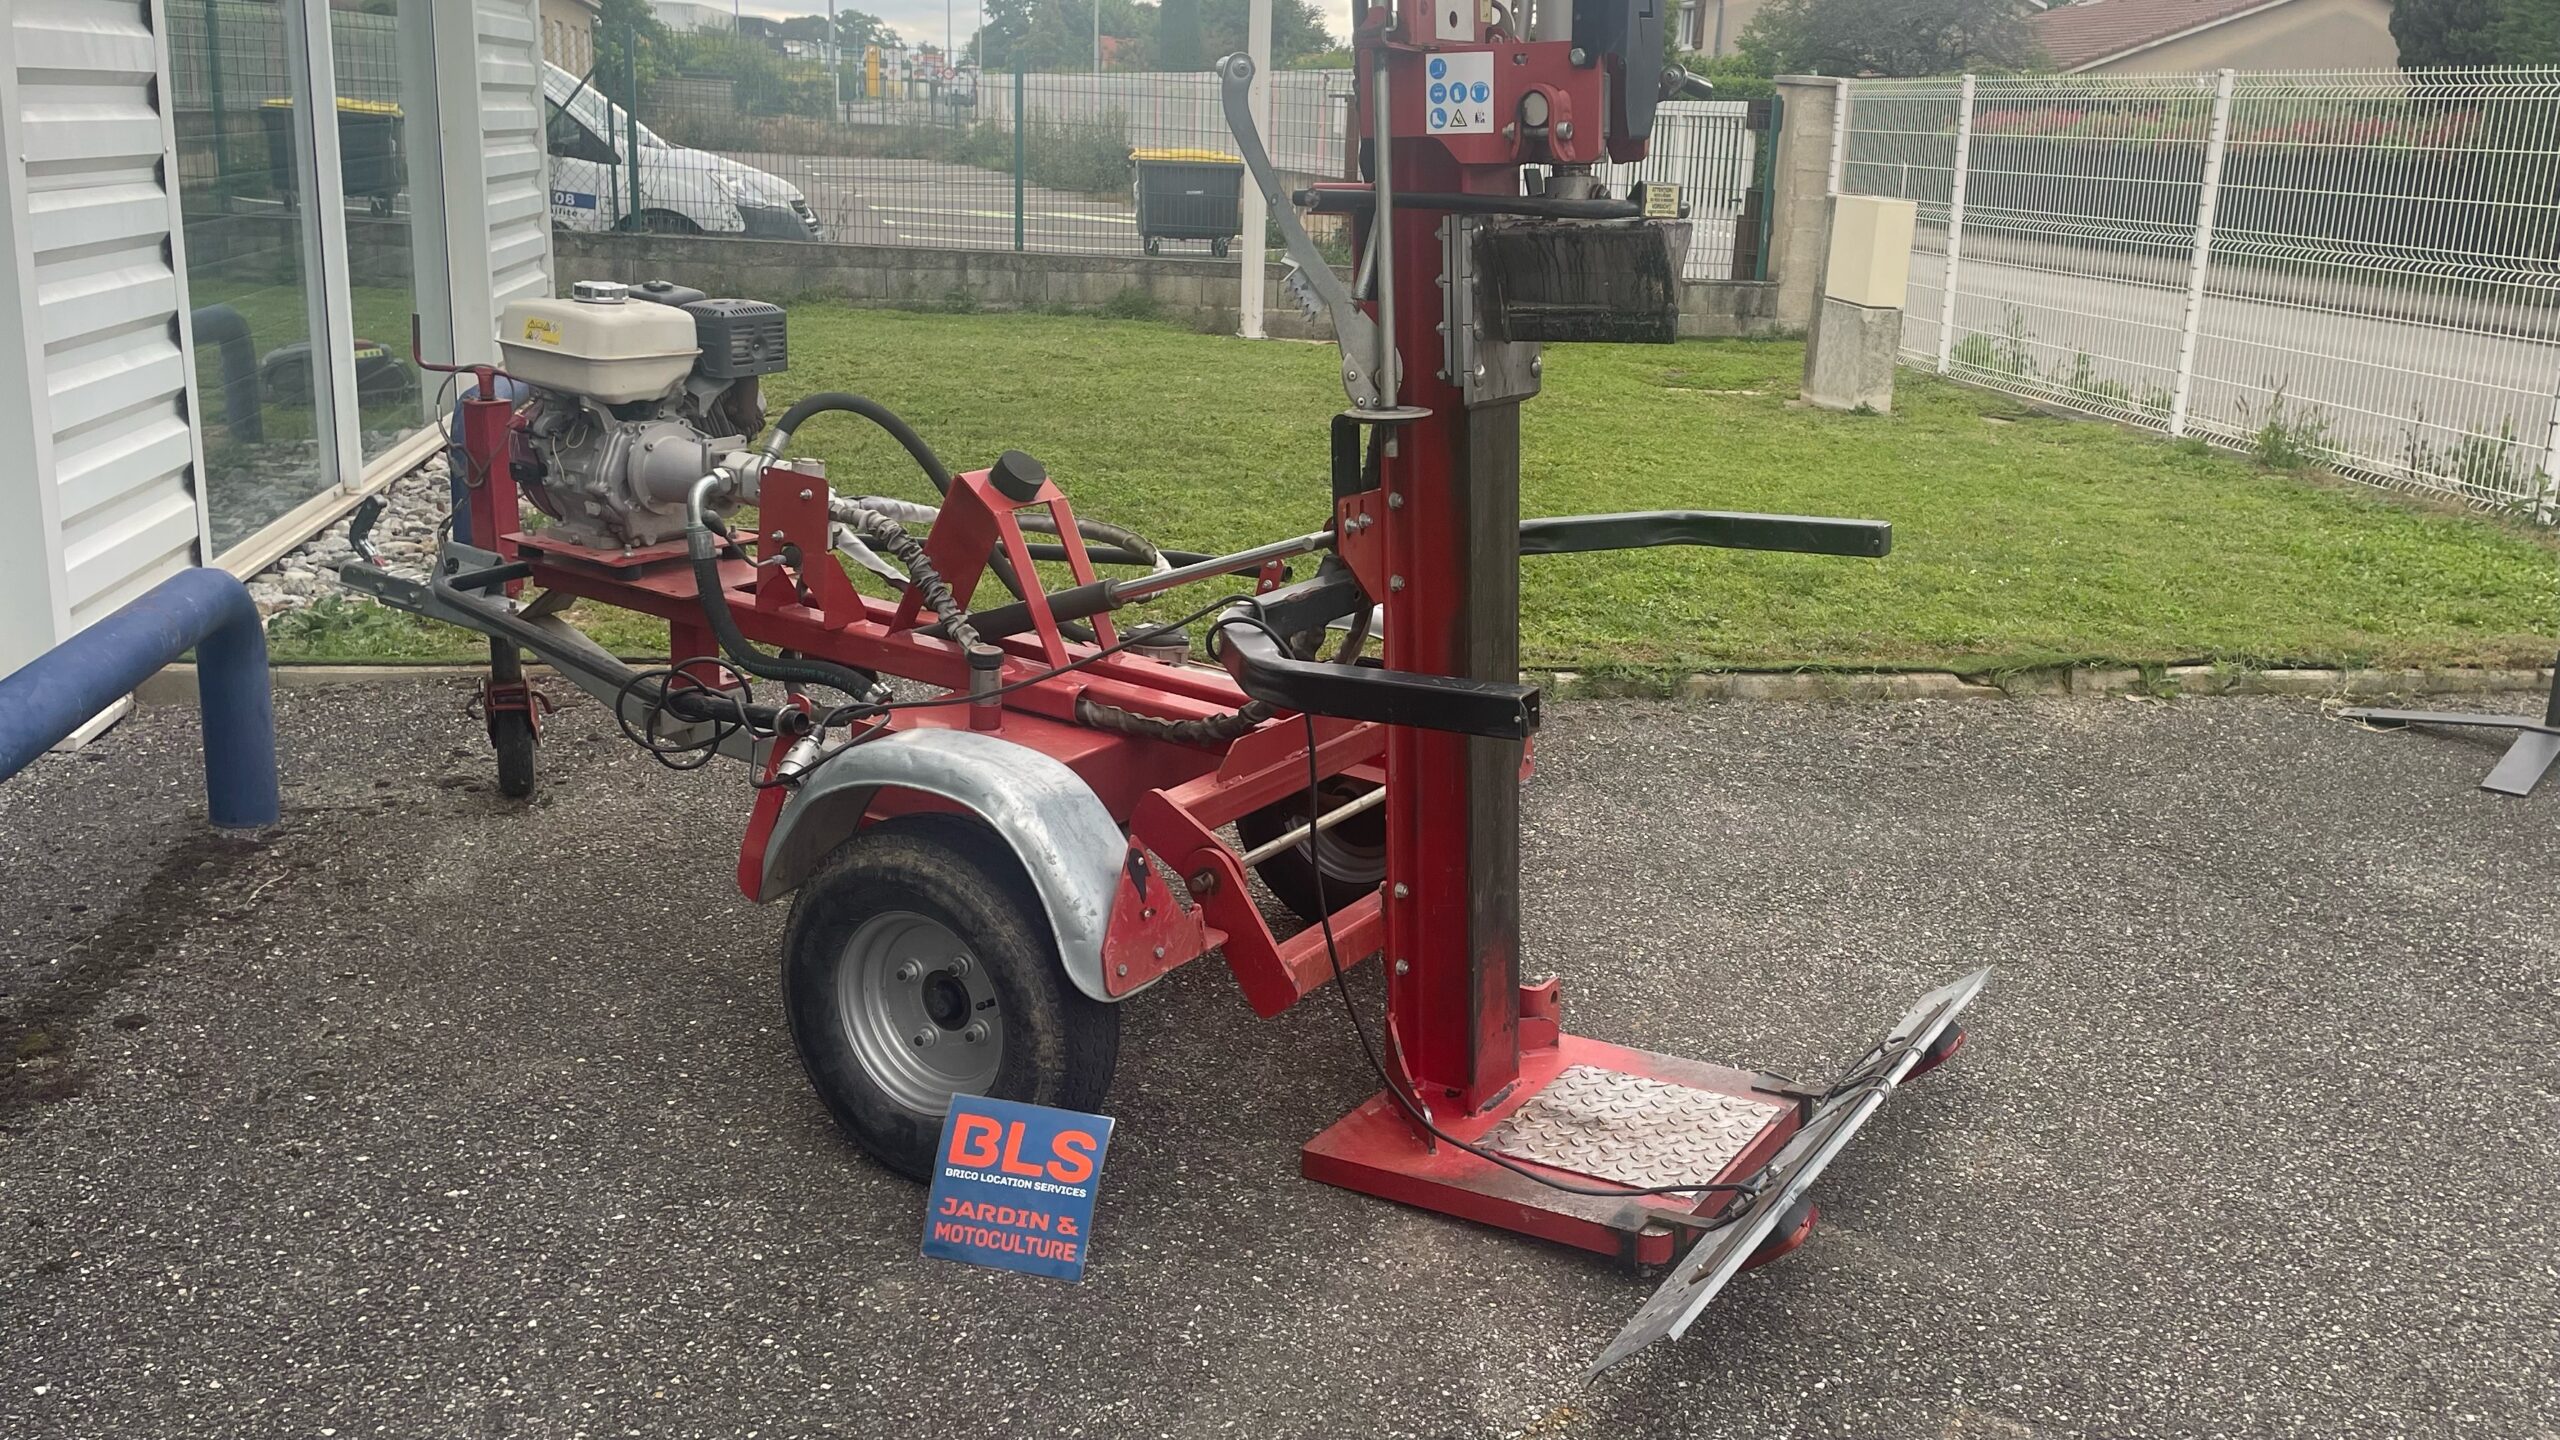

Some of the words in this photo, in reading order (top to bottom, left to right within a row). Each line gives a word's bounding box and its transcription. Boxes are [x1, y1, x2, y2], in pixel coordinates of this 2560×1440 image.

[948, 1113, 1097, 1183] BLS
[945, 1168, 978, 1180] BRICO
[980, 1174, 1031, 1189] LOCATION
[1034, 1182, 1087, 1197] SERVICES
[939, 1198, 1050, 1231] JARDIN
[1056, 1216, 1078, 1236] &
[935, 1222, 1077, 1262] MOTOCULTURE
